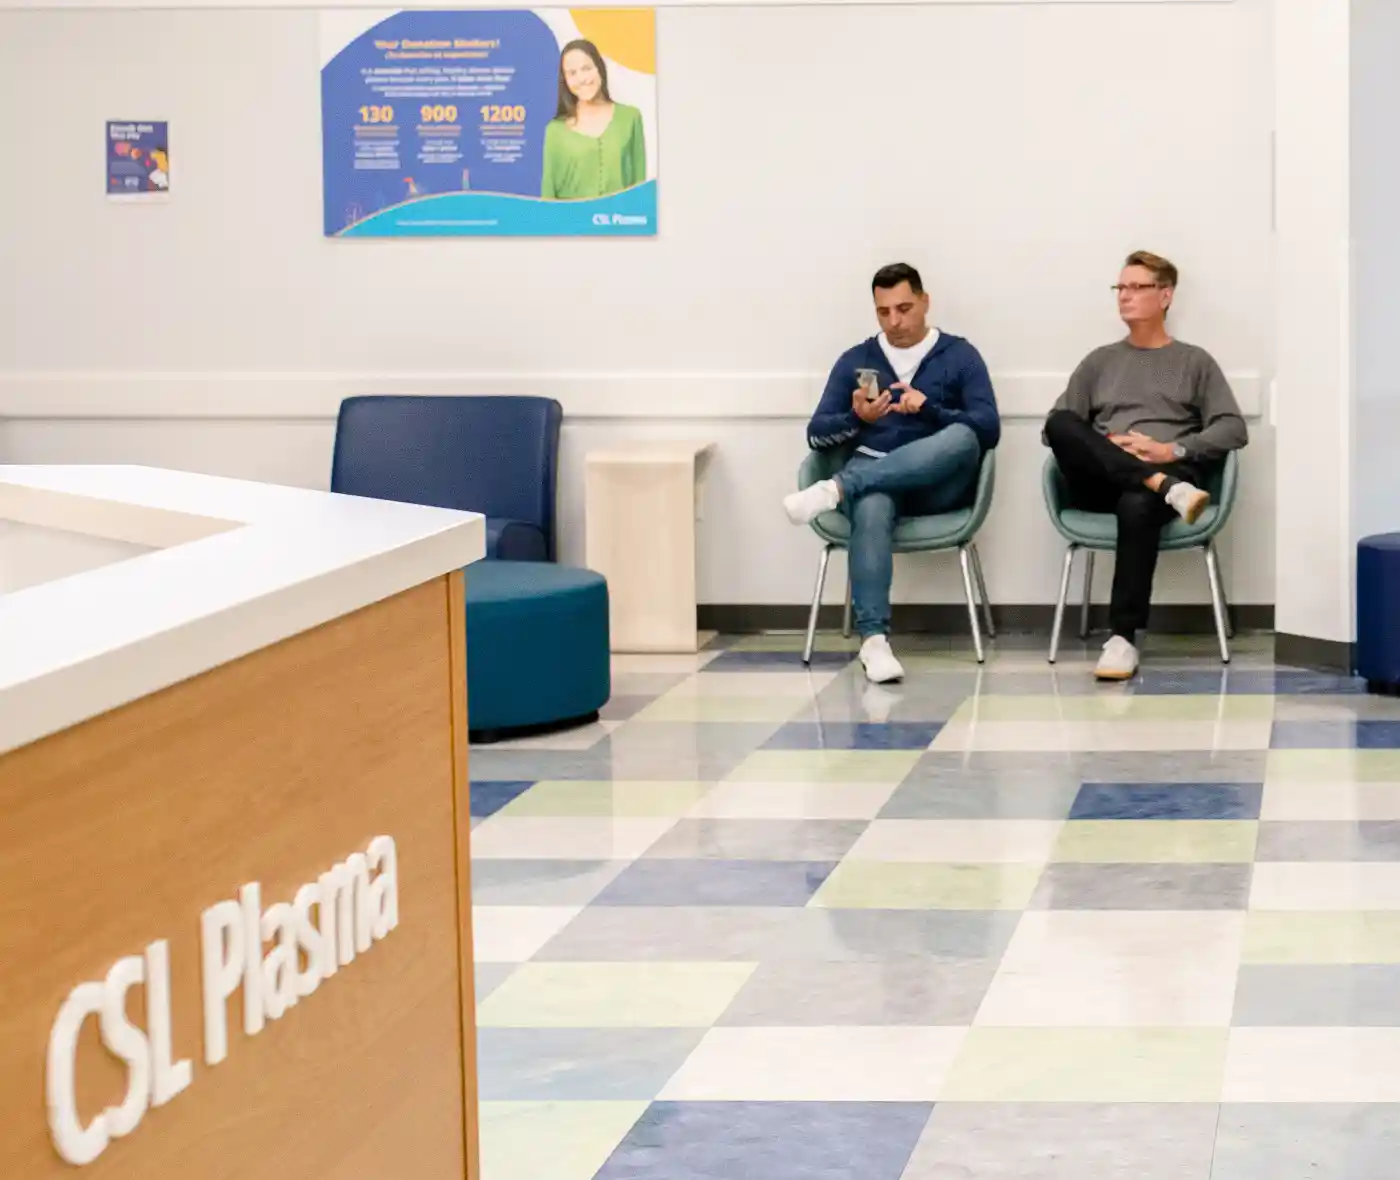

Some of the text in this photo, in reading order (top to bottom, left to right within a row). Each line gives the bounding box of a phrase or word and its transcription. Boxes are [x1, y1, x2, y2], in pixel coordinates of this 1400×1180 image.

[359, 105, 526, 123] 130 900 1200
[47, 835, 398, 1166] CSL Plasma
